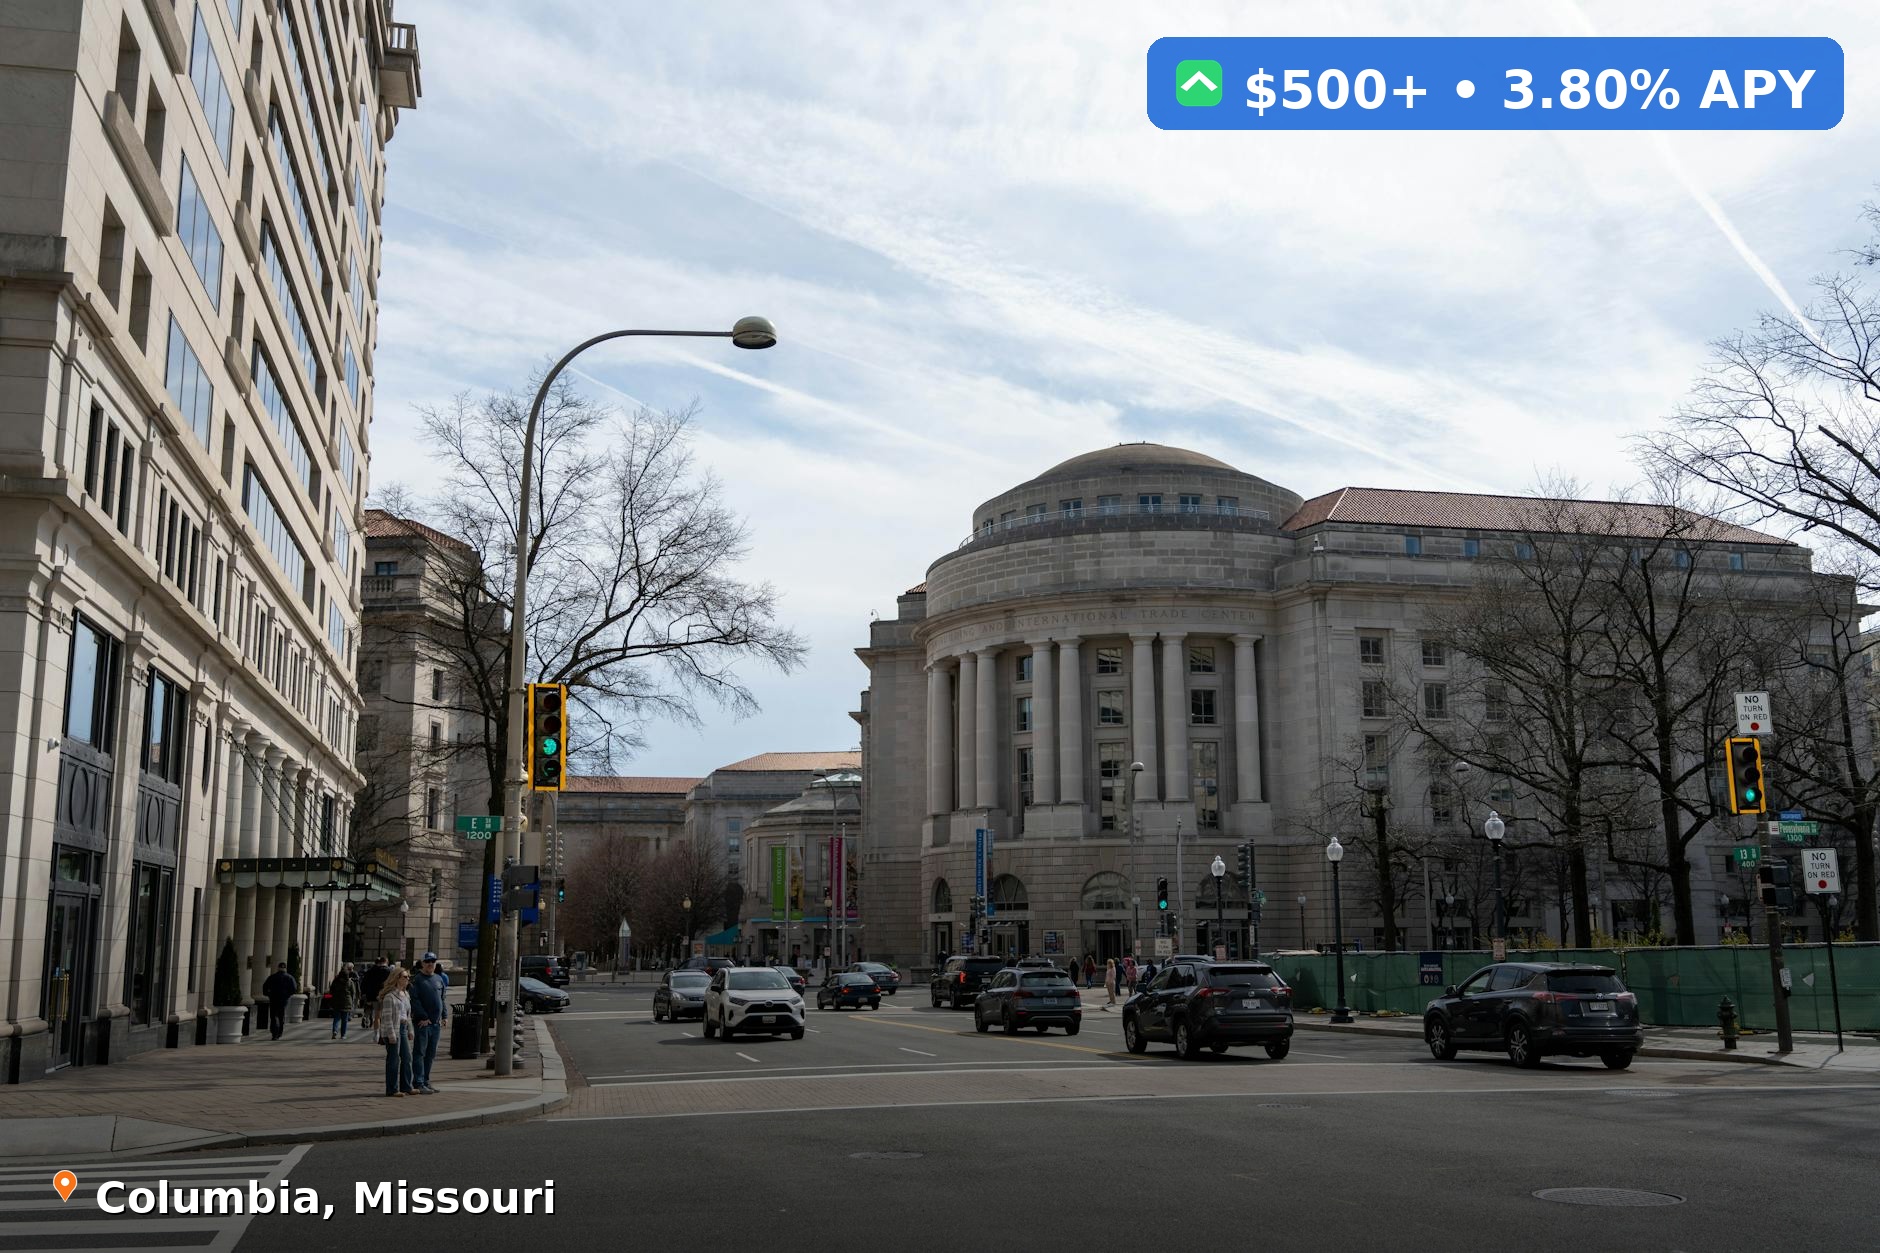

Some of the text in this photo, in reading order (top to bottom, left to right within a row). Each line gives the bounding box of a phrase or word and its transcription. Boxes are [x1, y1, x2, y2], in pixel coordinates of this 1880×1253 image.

[982, 621, 1004, 633] AND
[1012, 608, 1126, 630] INTERNATIONAL
[1140, 608, 1188, 620] TRADE
[1201, 609, 1256, 622] CENTER
[1745, 695, 1759, 704] NO
[1743, 704, 1763, 712] TURN
[1740, 713, 1768, 721] ON RED
[471, 818, 478, 829] E
[466, 831, 492, 840] 1200
[1787, 834, 1803, 842] 1300
[1739, 849, 1748, 860] 13
[1812, 852, 1827, 861] NO
[1741, 860, 1756, 868] 400
[1810, 862, 1831, 870] TURN
[1807, 871, 1836, 879] ON RED
